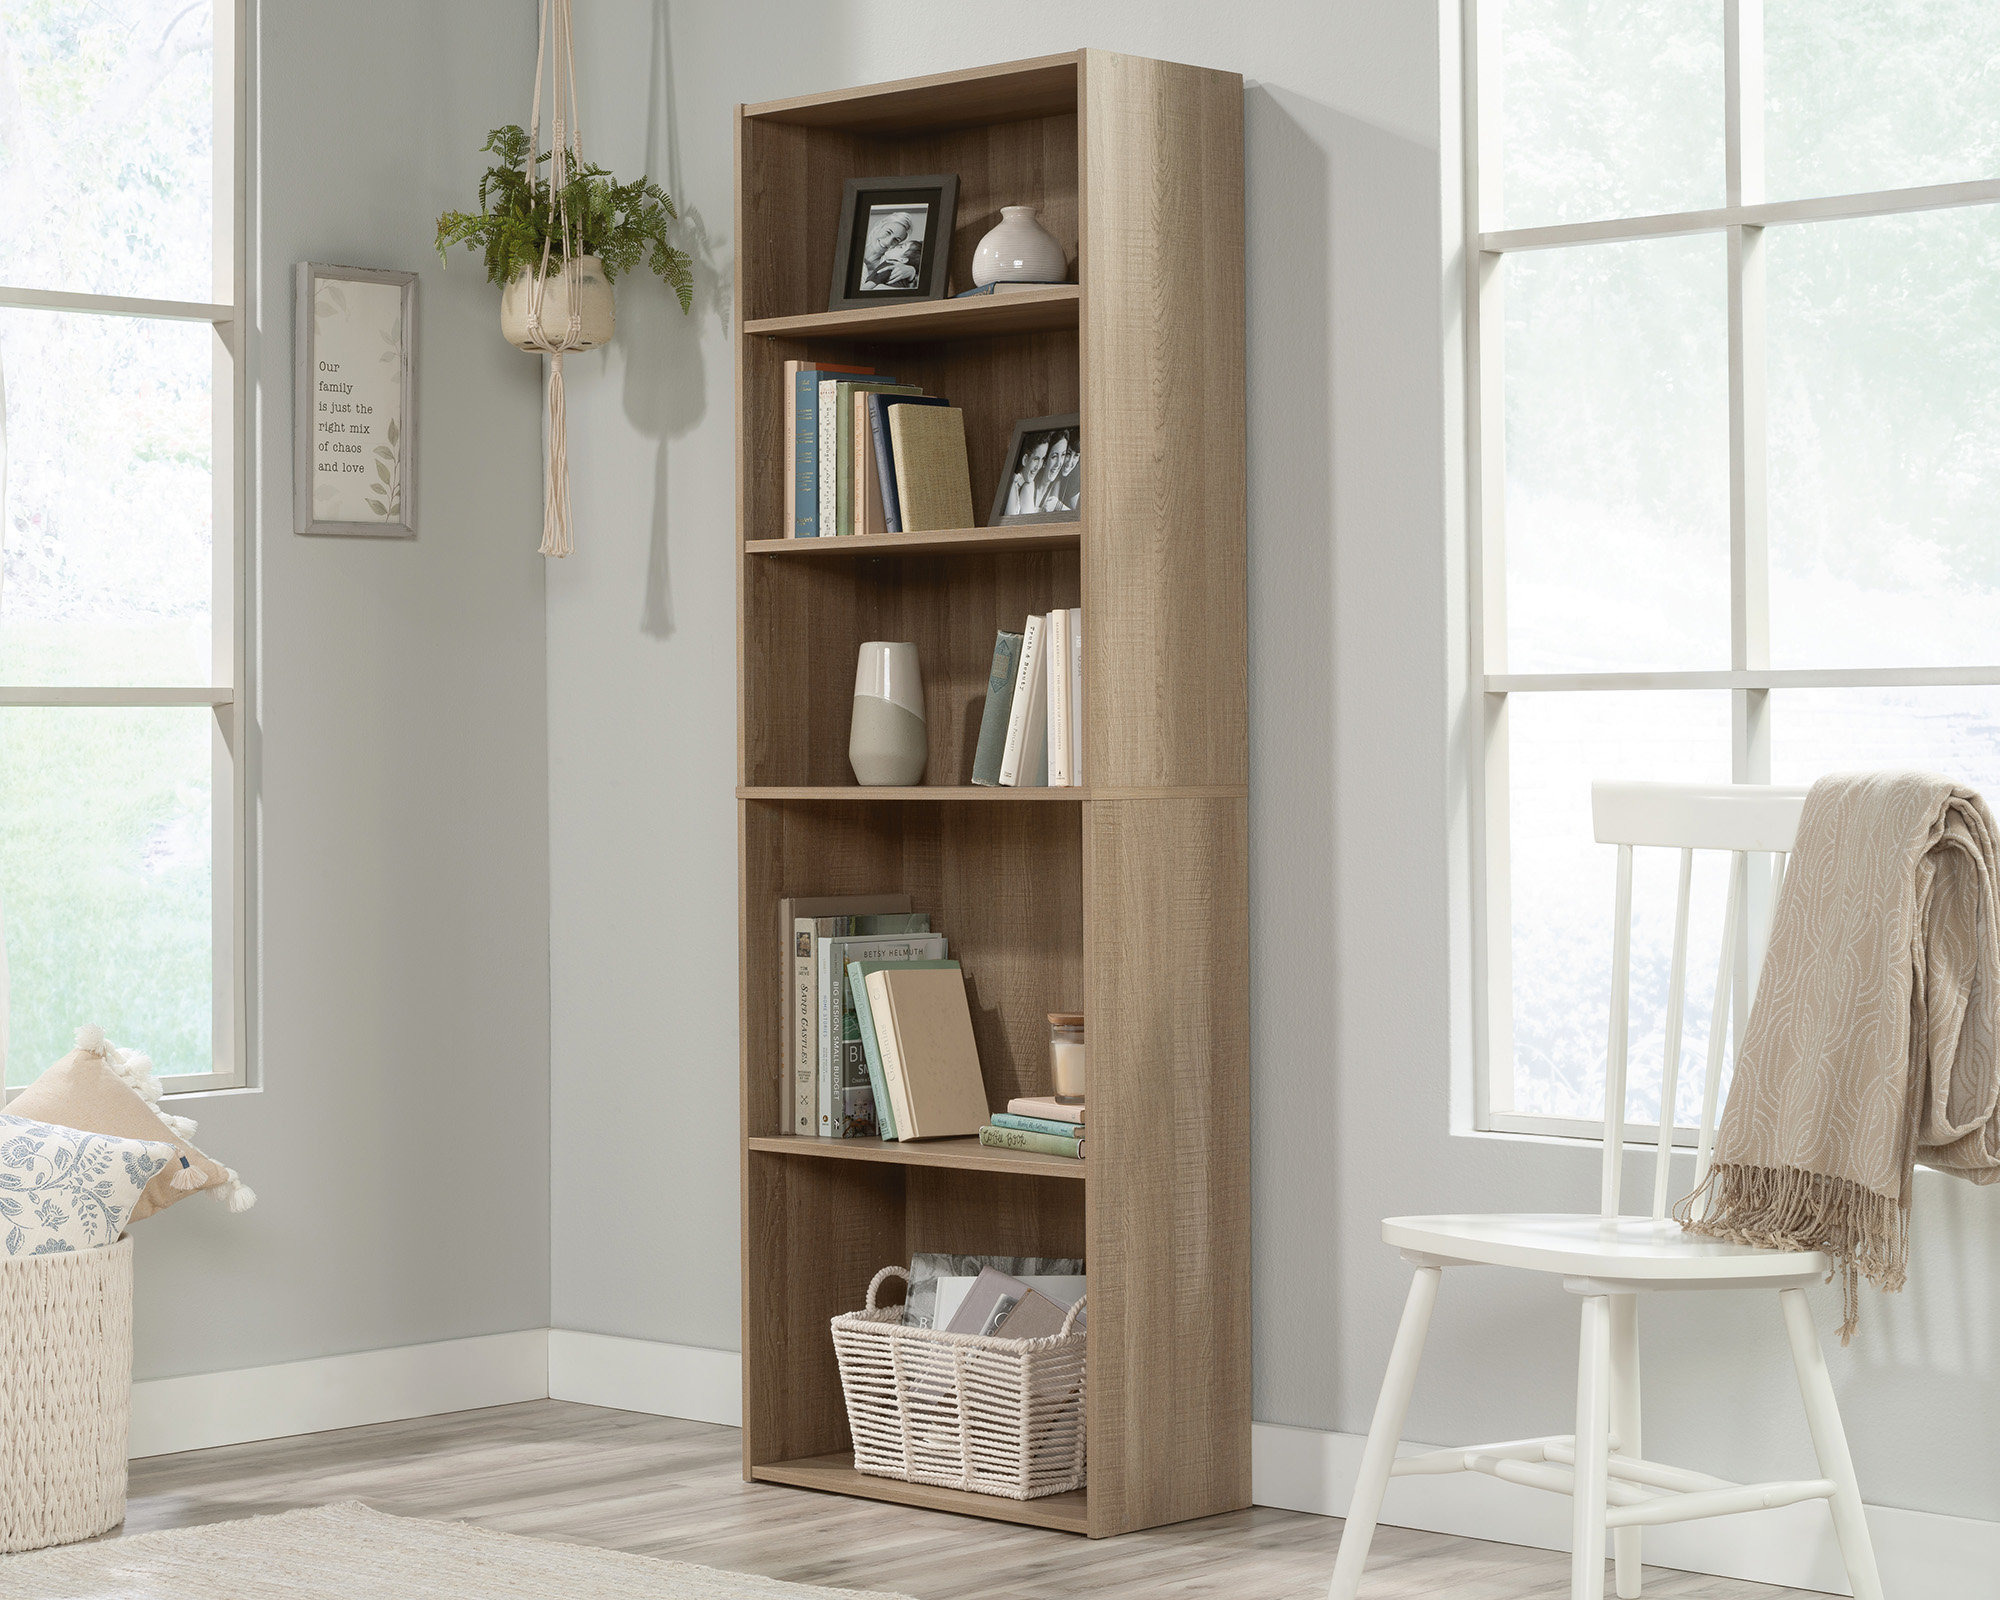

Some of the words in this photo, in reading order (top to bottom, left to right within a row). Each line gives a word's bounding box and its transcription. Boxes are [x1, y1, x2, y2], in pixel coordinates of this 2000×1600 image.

[318, 360, 340, 373] Our
[318, 381, 354, 394] family
[318, 402, 329, 412] is
[330, 402, 352, 414] just
[356, 403, 374, 414] the
[318, 422, 346, 434] right
[350, 423, 370, 434] mix
[318, 442, 330, 452] of
[332, 442, 362, 454] chaos
[318, 461, 338, 473] and
[342, 462, 365, 474] love
[1026, 626, 1035, 650] Truth
[1019, 662, 1029, 692] Beauty
[863, 948, 886, 959] BETSY
[888, 947, 924, 958] HELMUTH
[800, 984, 809, 1016] SAND
[800, 1018, 809, 1065] CASTLES
[882, 1024, 896, 1082] Gardenias
[983, 1129, 1004, 1145] Coffee
[1006, 1133, 1026, 1147] Book
